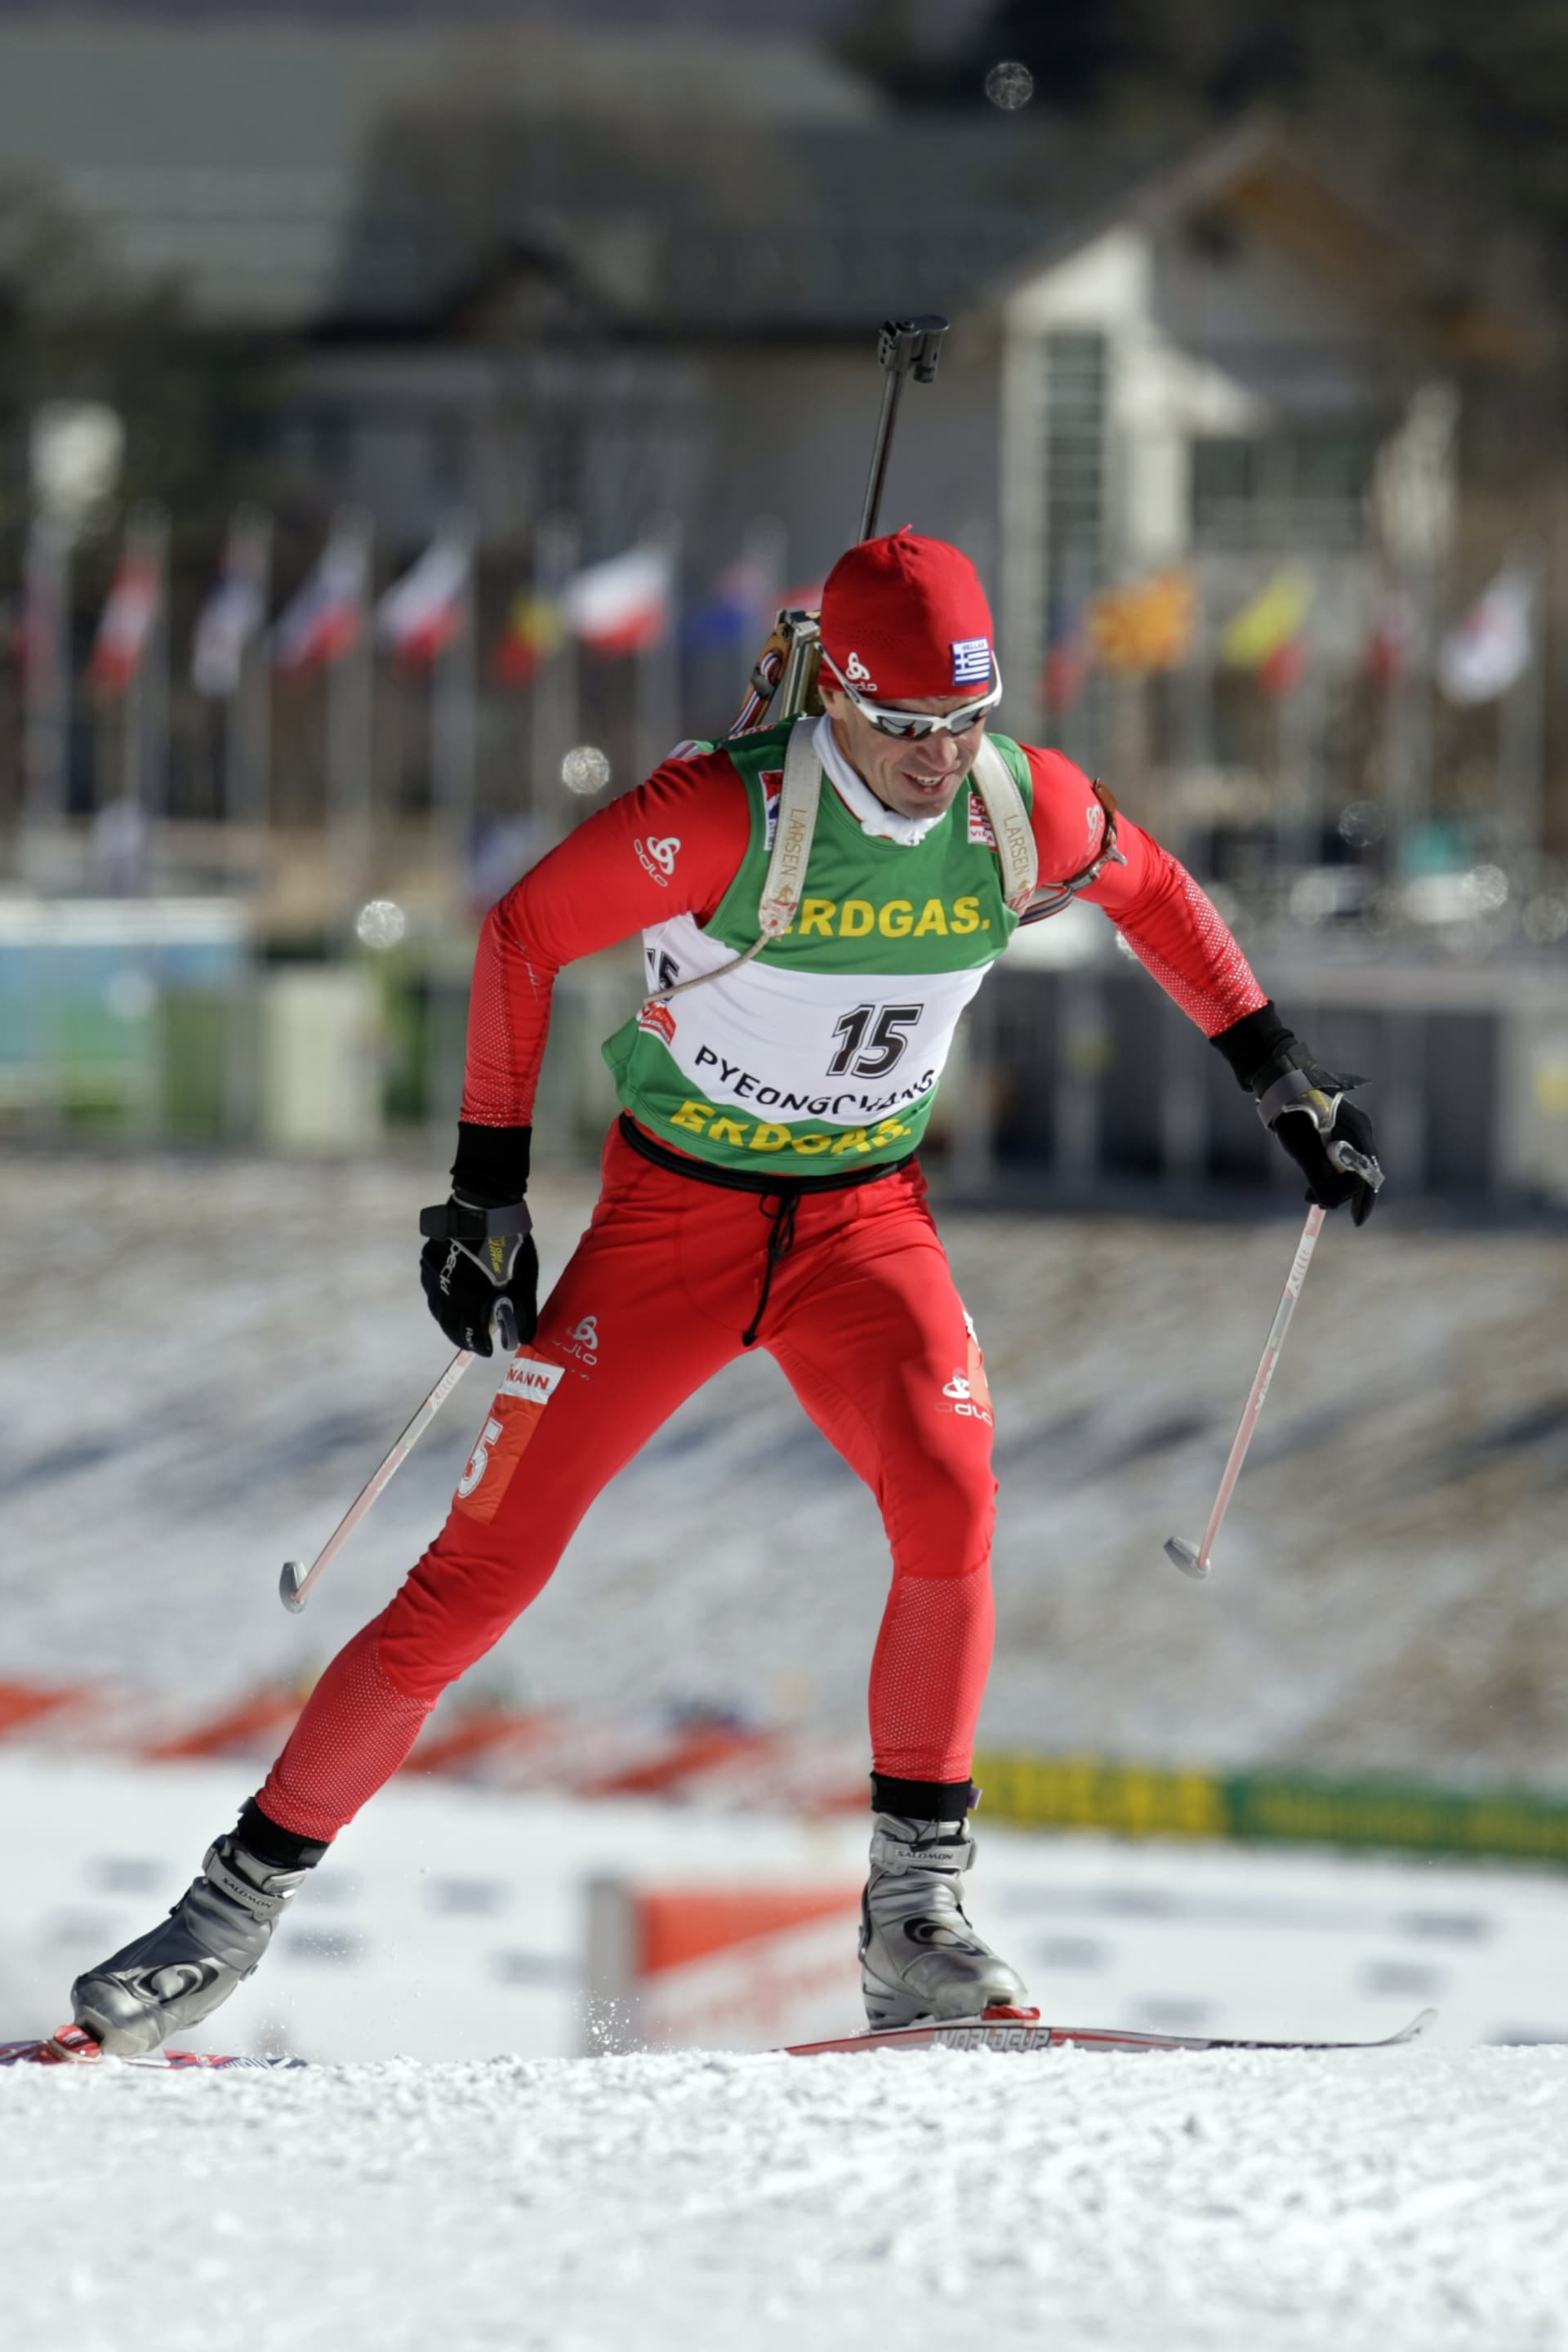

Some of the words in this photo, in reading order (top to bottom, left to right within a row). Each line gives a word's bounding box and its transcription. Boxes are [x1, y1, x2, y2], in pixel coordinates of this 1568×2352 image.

[779, 808, 807, 877] LARSEN
[1003, 814, 1029, 876] LARSEN
[782, 896, 991, 938] RDGAS.
[826, 1004, 924, 1080] 15
[898, 1849, 954, 1860] SALOMON
[223, 1877, 273, 1909] SALOMON
